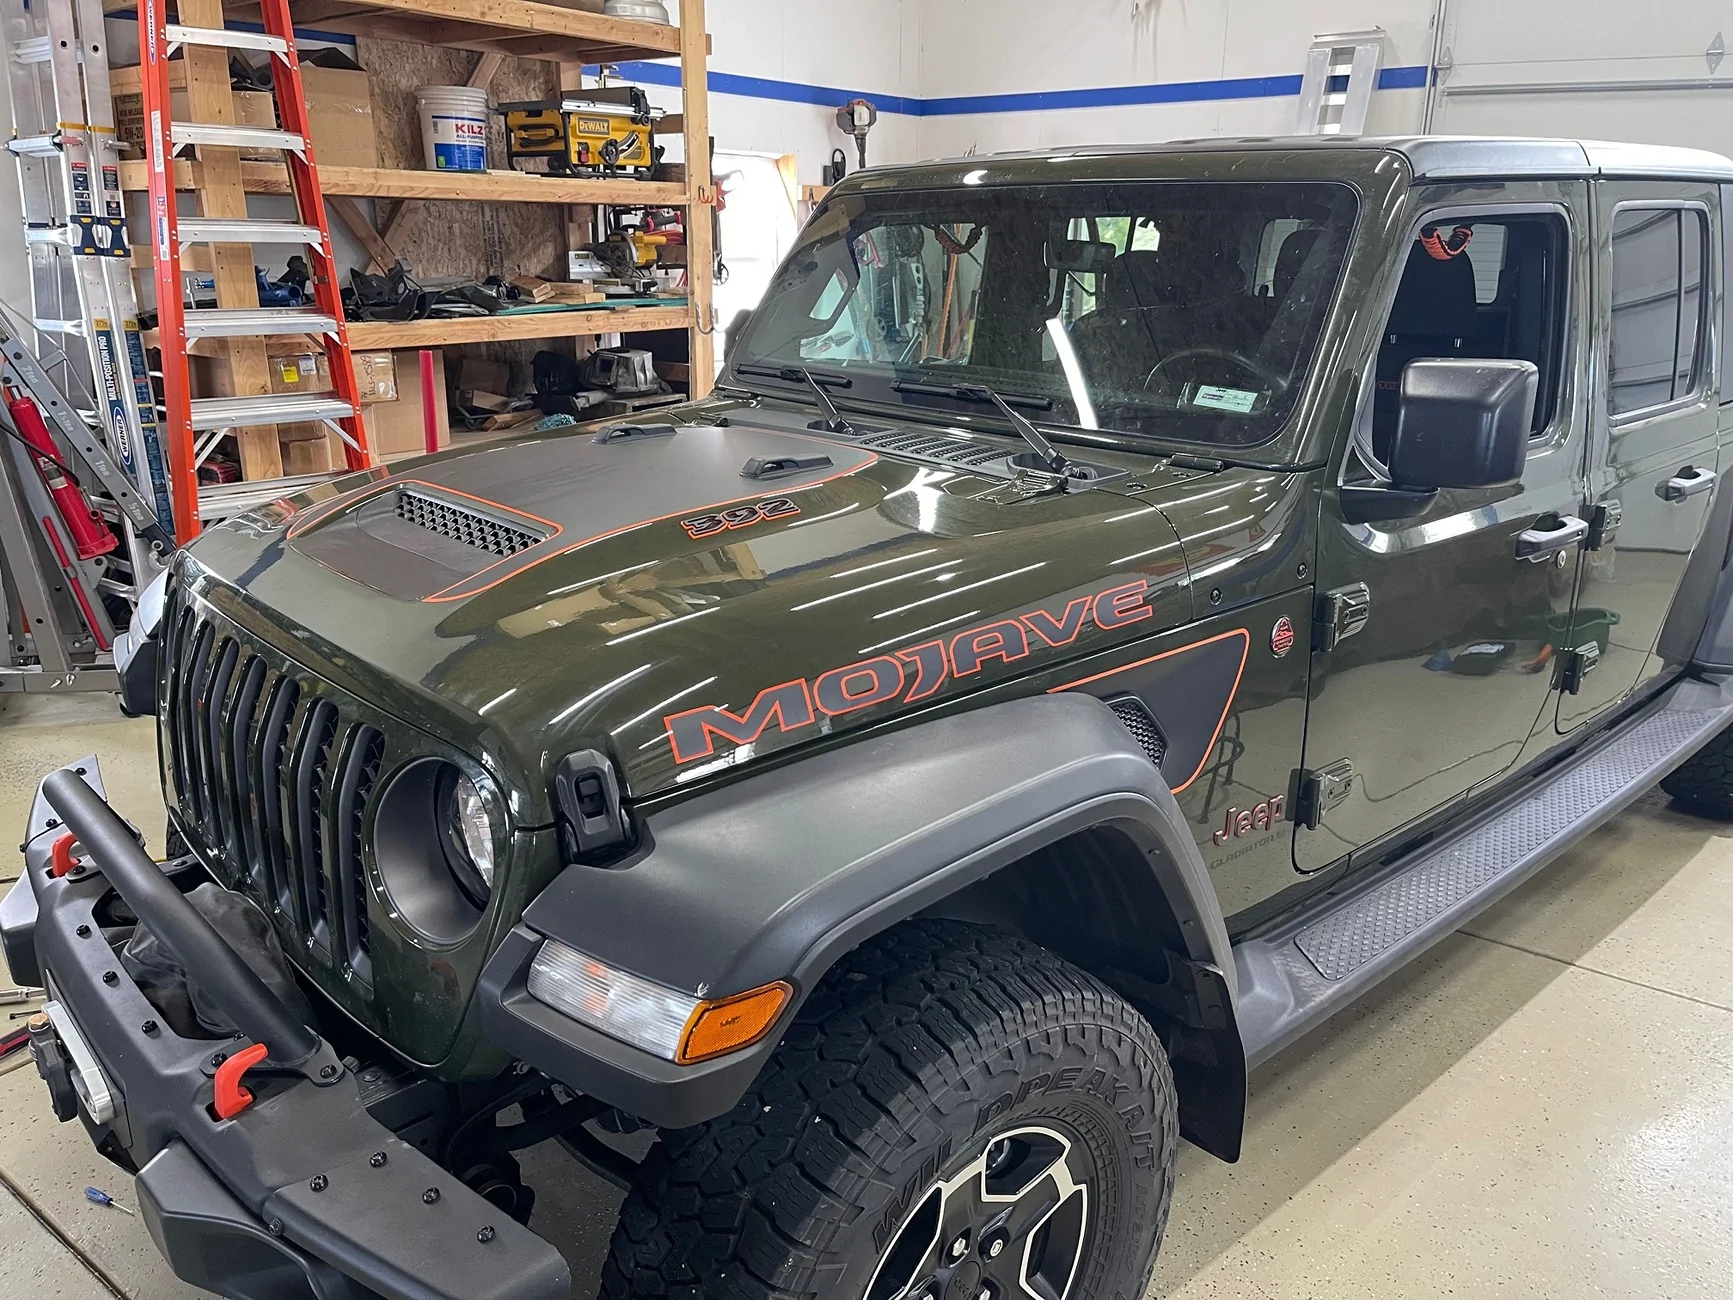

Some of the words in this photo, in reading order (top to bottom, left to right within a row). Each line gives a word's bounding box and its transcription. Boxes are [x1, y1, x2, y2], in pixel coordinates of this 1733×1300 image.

[124, 126, 144, 140] 5W-20
[455, 123, 484, 135] KILZ
[97, 336, 108, 351] PRO
[117, 418, 129, 454] WERNER
[681, 497, 801, 540] 392
[663, 579, 1153, 764] MOJAVE
[1212, 794, 1284, 847] Jeep
[1210, 835, 1275, 870] GLADIATOR
